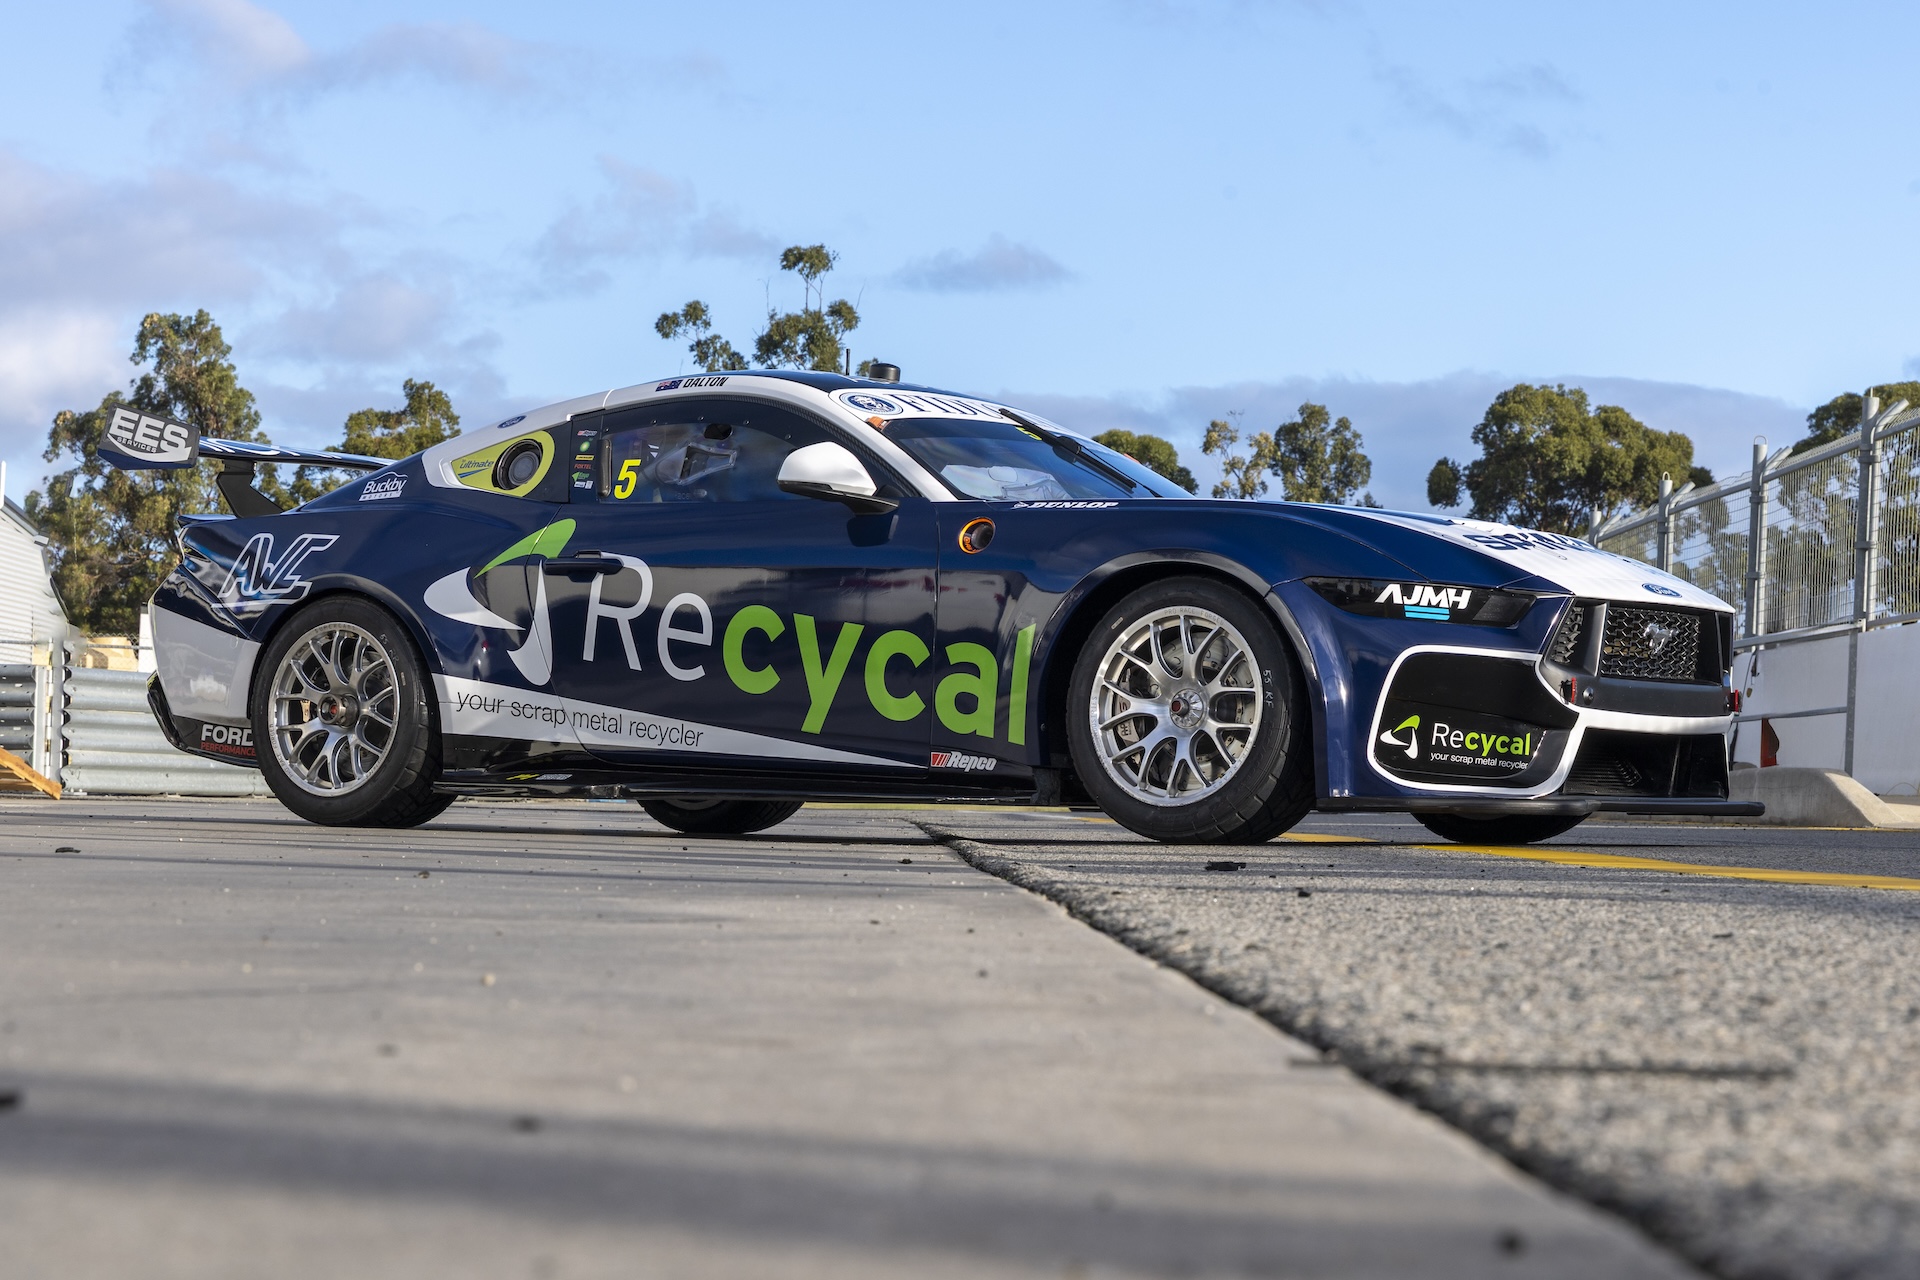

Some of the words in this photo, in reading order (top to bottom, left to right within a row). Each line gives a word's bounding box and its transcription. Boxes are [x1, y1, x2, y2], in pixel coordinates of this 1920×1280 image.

[683, 376, 729, 388] DALTON
[108, 408, 189, 452] EES
[116, 436, 157, 453] SERVICES
[459, 460, 495, 469] ultimate
[363, 477, 407, 494] Buckby
[614, 459, 641, 499] 5
[1026, 501, 1119, 509] DUNLOP
[1375, 583, 1473, 610] AJMH
[1180, 607, 1196, 615] RACE
[582, 551, 1037, 746] Recycal
[456, 692, 504, 714] your
[510, 701, 566, 729] scrap
[572, 712, 622, 734] metal
[629, 723, 704, 747] recycler
[1431, 722, 1532, 757] Recycal
[200, 742, 257, 757] PERFORMANCE
[946, 751, 997, 772] Repco
[1430, 752, 1449, 762] your
[1450, 754, 1473, 765] scrap
[1475, 757, 1497, 767] metal
[1498, 759, 1528, 770] recycler
